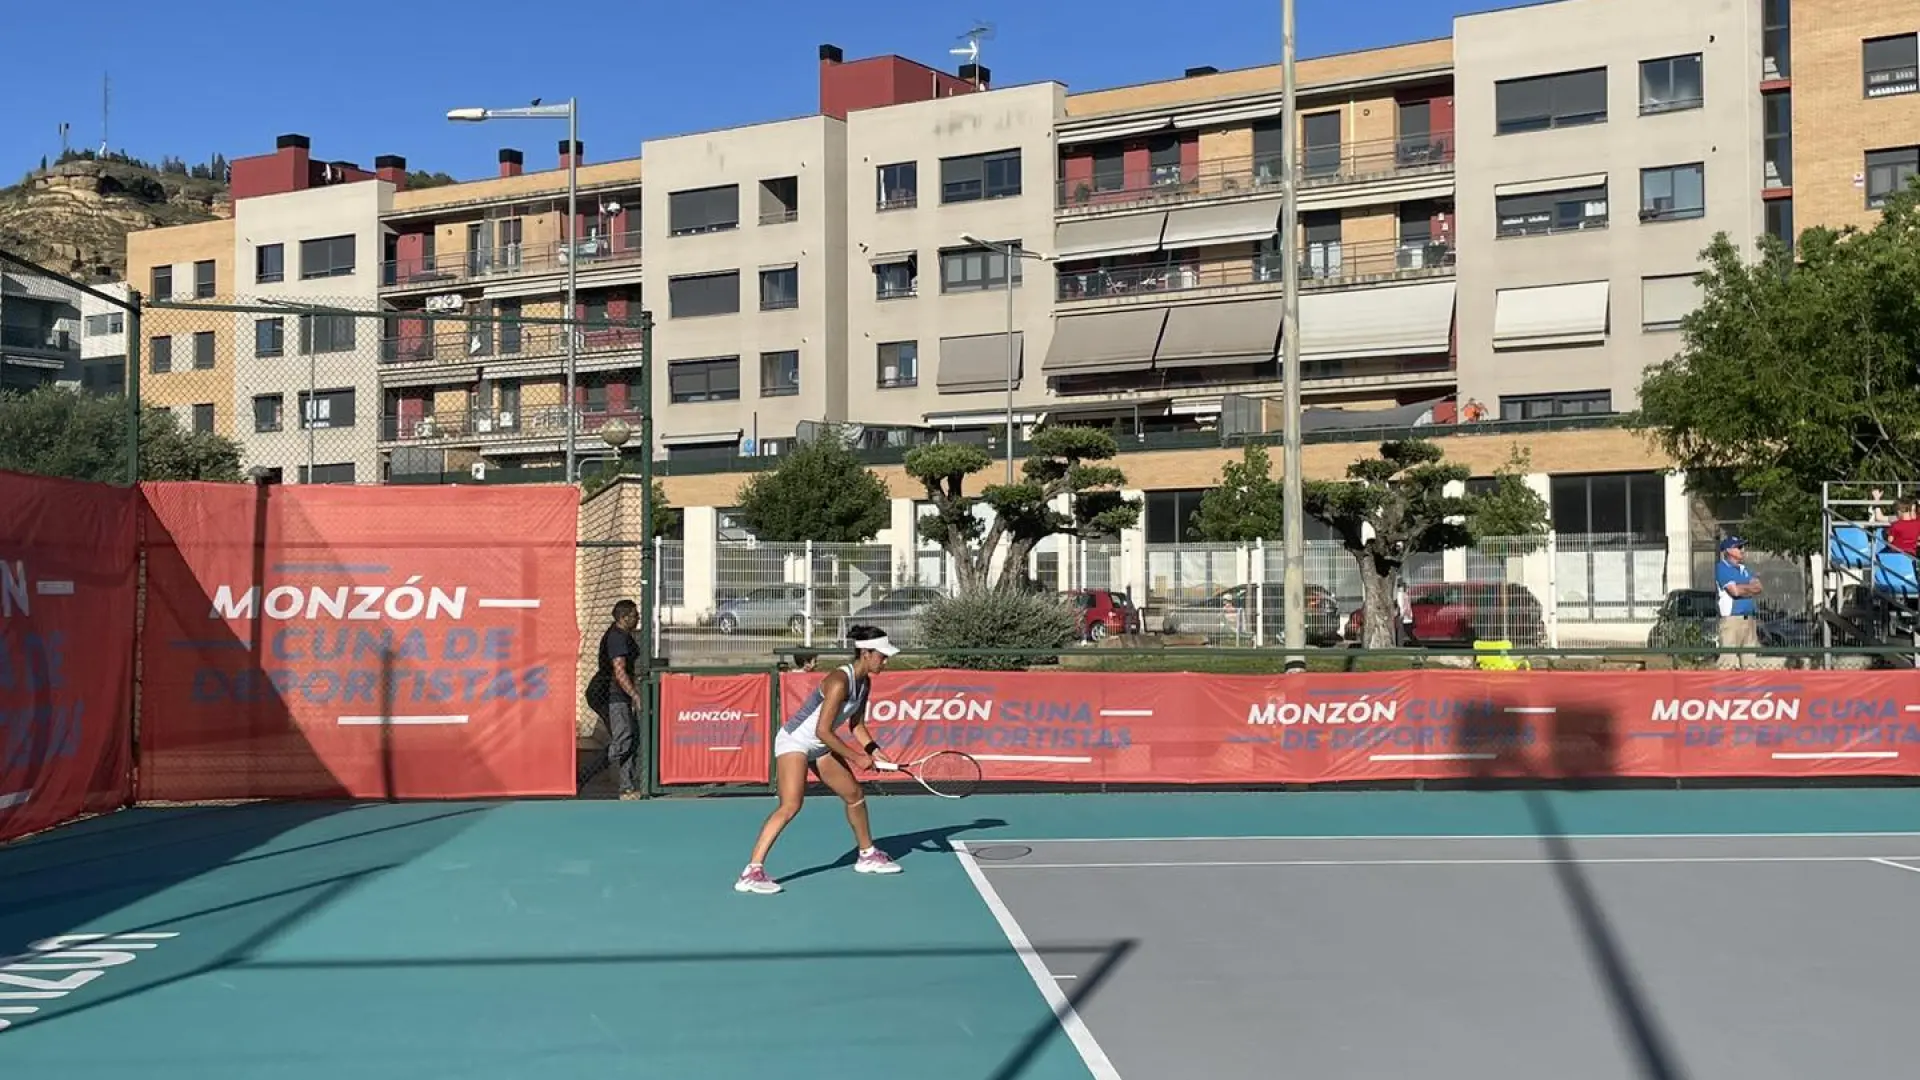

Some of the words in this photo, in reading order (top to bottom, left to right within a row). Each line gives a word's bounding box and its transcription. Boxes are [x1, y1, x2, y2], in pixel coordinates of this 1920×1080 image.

[209, 575, 468, 620] MONZÓN
[271, 627, 429, 661] CUNA
[442, 627, 516, 661] DE
[191, 665, 550, 705] DEPORTISTAS
[678, 708, 741, 721] MONZÓN
[1000, 700, 1093, 726] CUNA
[1248, 695, 1397, 724] MONZÓN
[1405, 697, 1495, 720] CUNA
[1651, 692, 1801, 721] MONZÓN
[1807, 698, 1899, 720] CUNA
[924, 725, 1132, 750] DEPORTISTAS
[1281, 726, 1324, 750] DE
[1684, 724, 1724, 746] DE
[1731, 723, 1920, 747] DEPORTISTA
